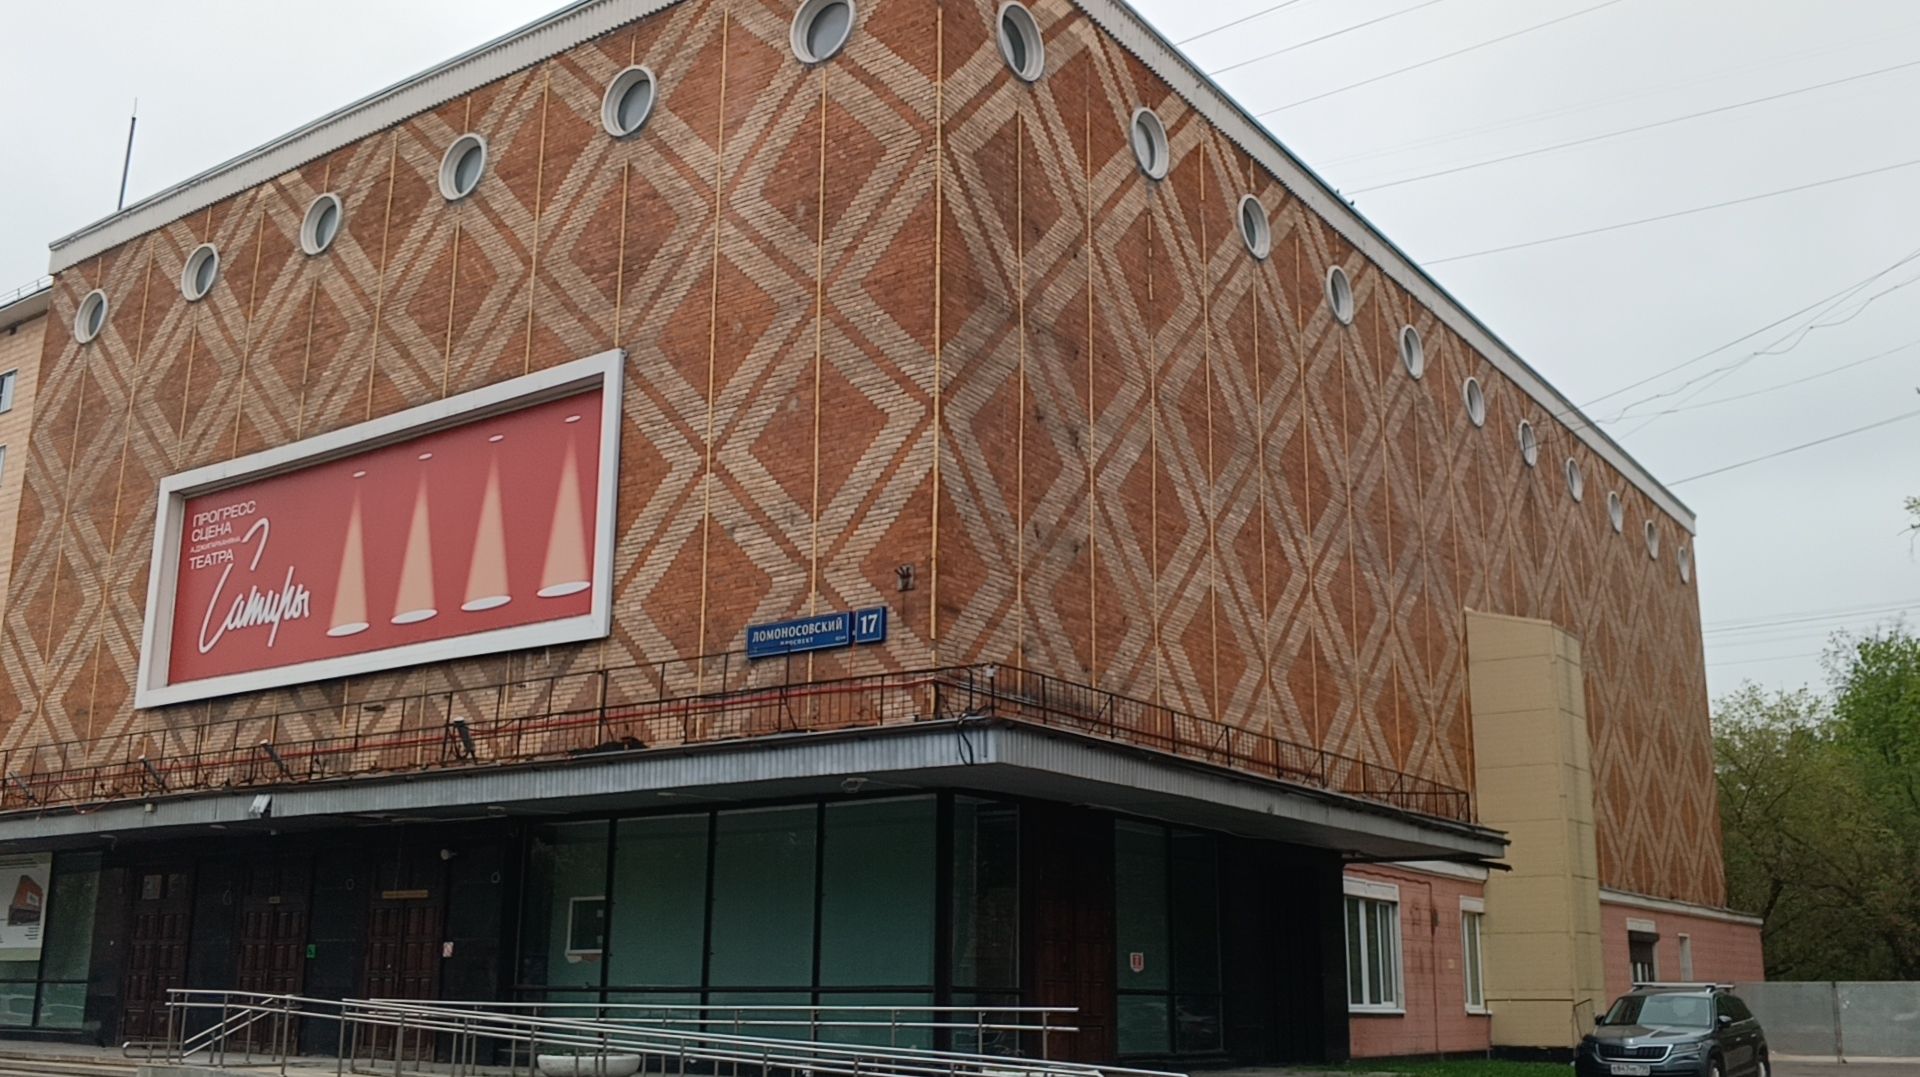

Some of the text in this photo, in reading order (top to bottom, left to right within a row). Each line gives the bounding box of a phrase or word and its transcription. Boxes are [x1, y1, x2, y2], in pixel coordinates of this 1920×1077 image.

[193, 500, 256, 527] ПРОГРЕСС
[191, 521, 232, 543] СЦЕНА
[189, 548, 234, 570] ТЕАТРА
[752, 617, 843, 643] ЛОМОНОСОВСКИЙ
[860, 614, 878, 635] 17
